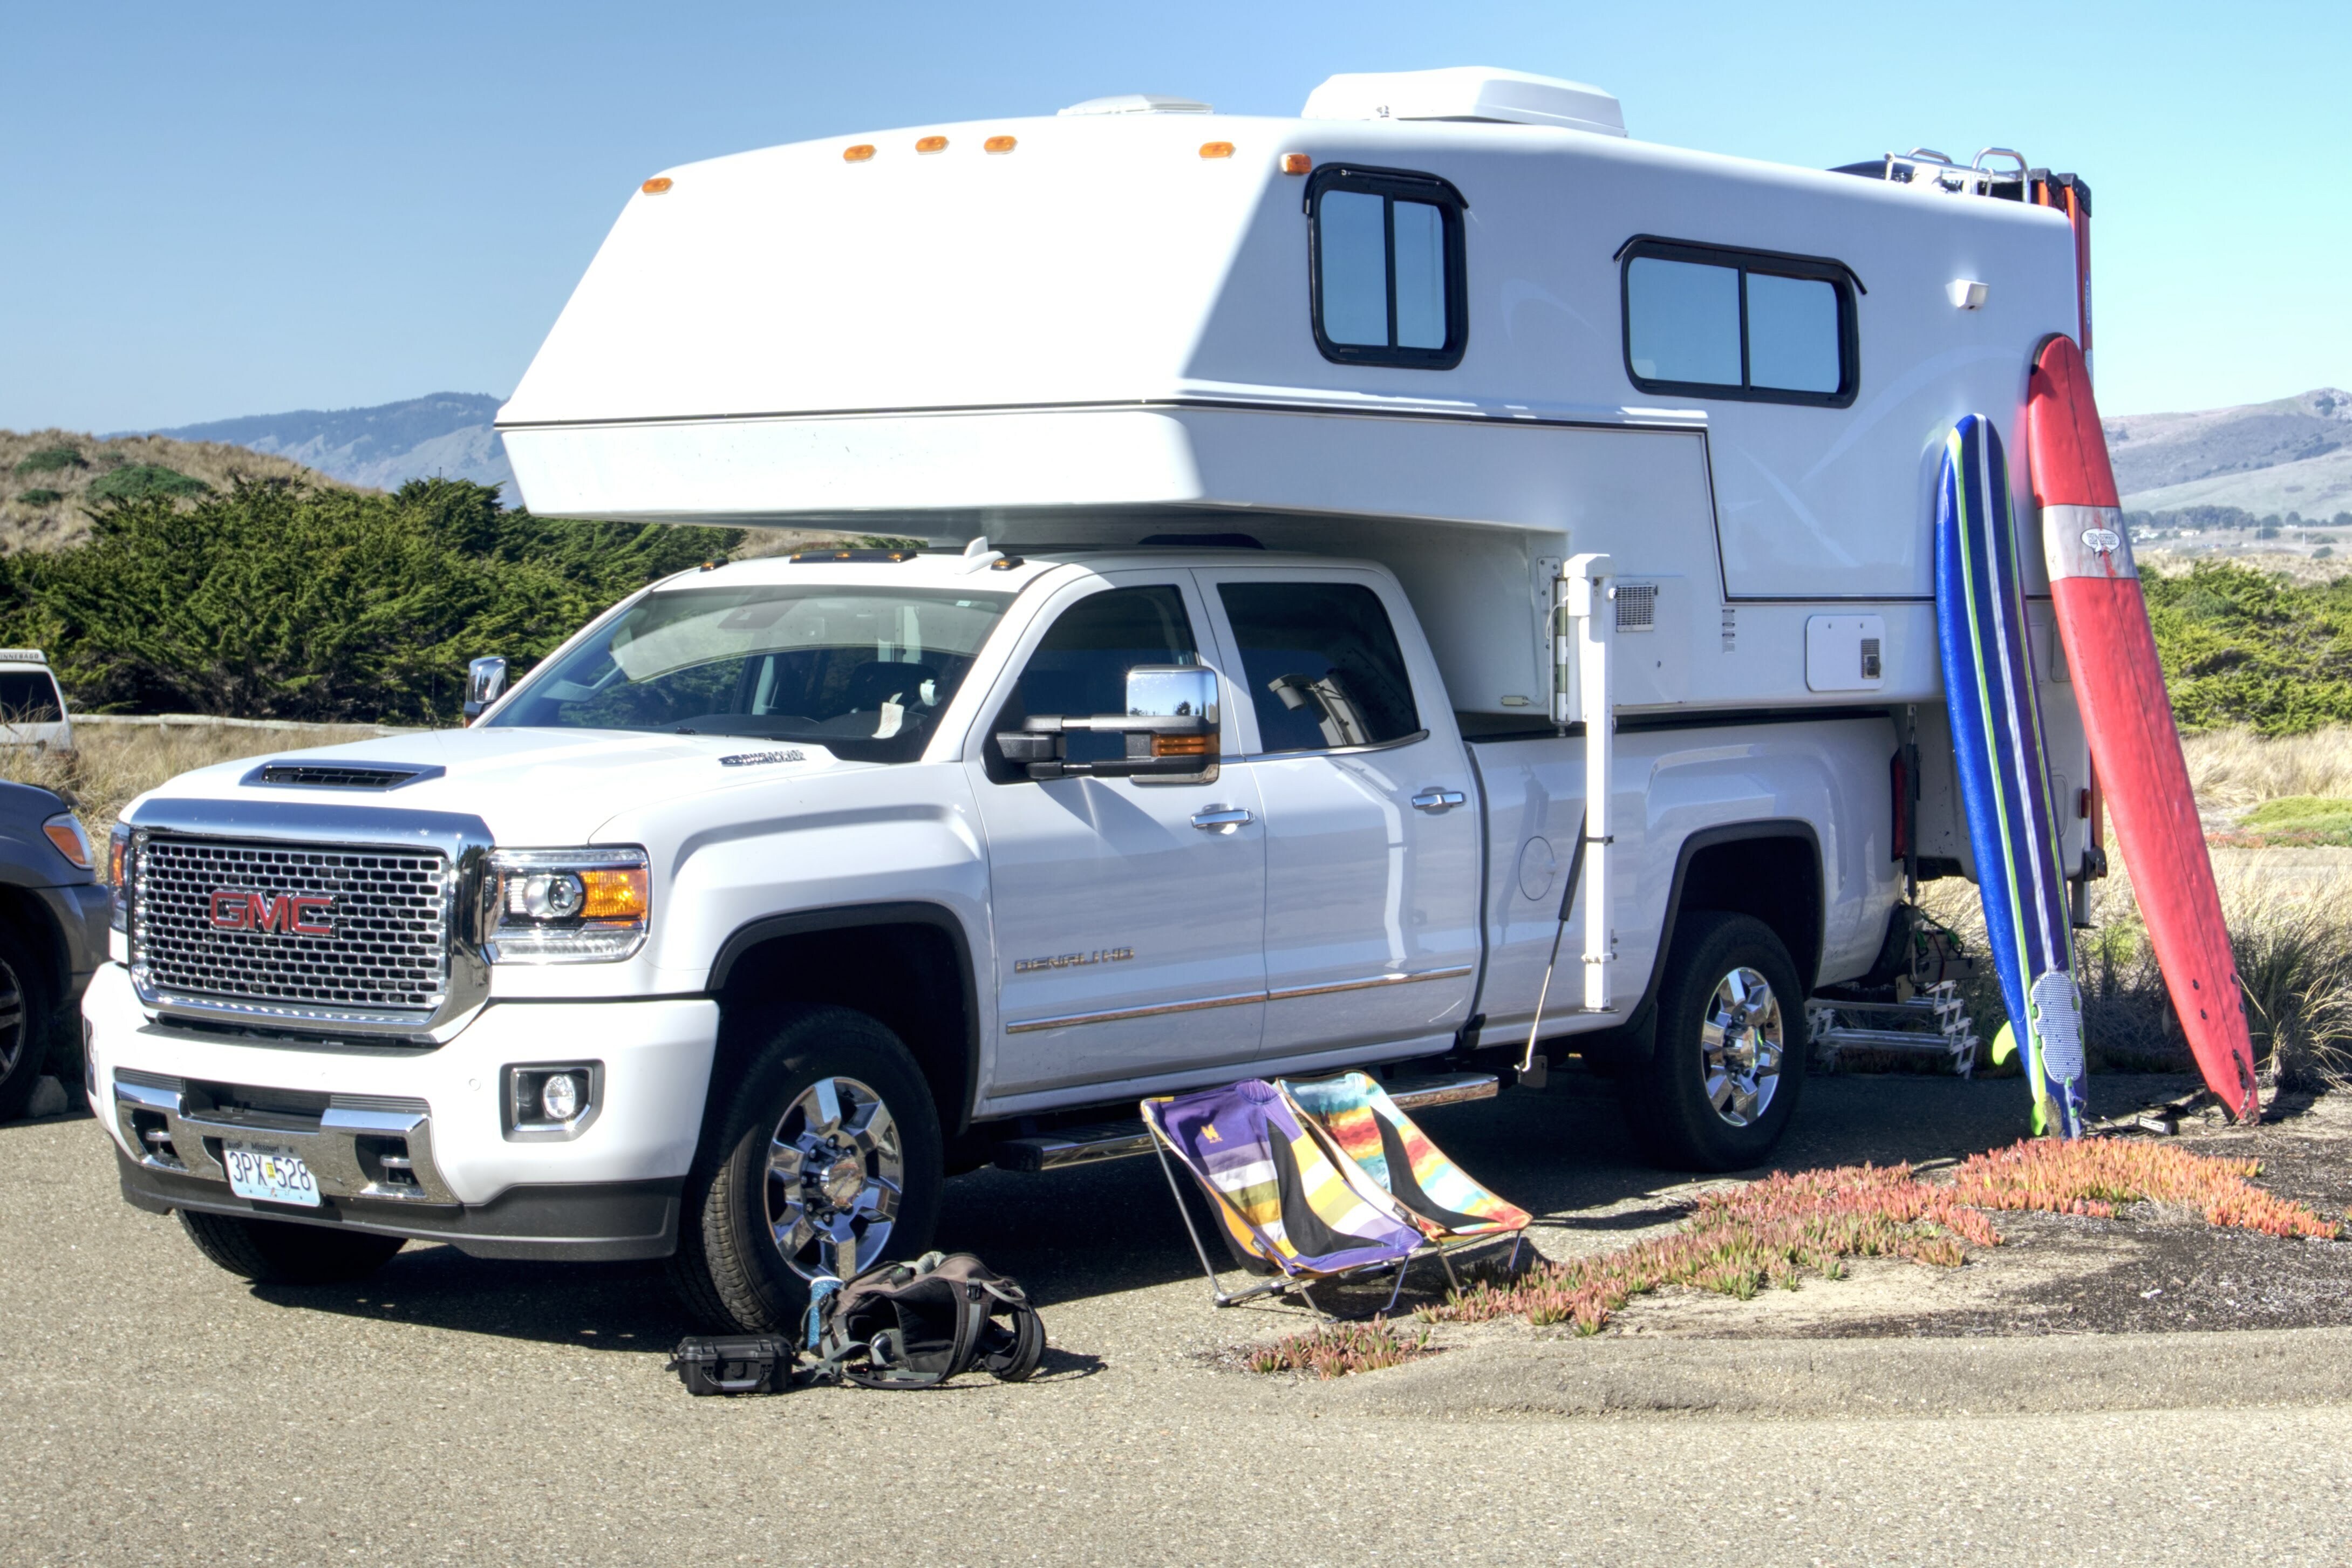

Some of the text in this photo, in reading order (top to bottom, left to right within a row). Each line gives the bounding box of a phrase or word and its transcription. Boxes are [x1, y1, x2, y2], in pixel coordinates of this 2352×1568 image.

[210, 890, 335, 937] GMC
[1014, 946, 1135, 973] DENALI HD
[251, 1142, 280, 1153] Missouri
[229, 1151, 311, 1191] 3PX 528
